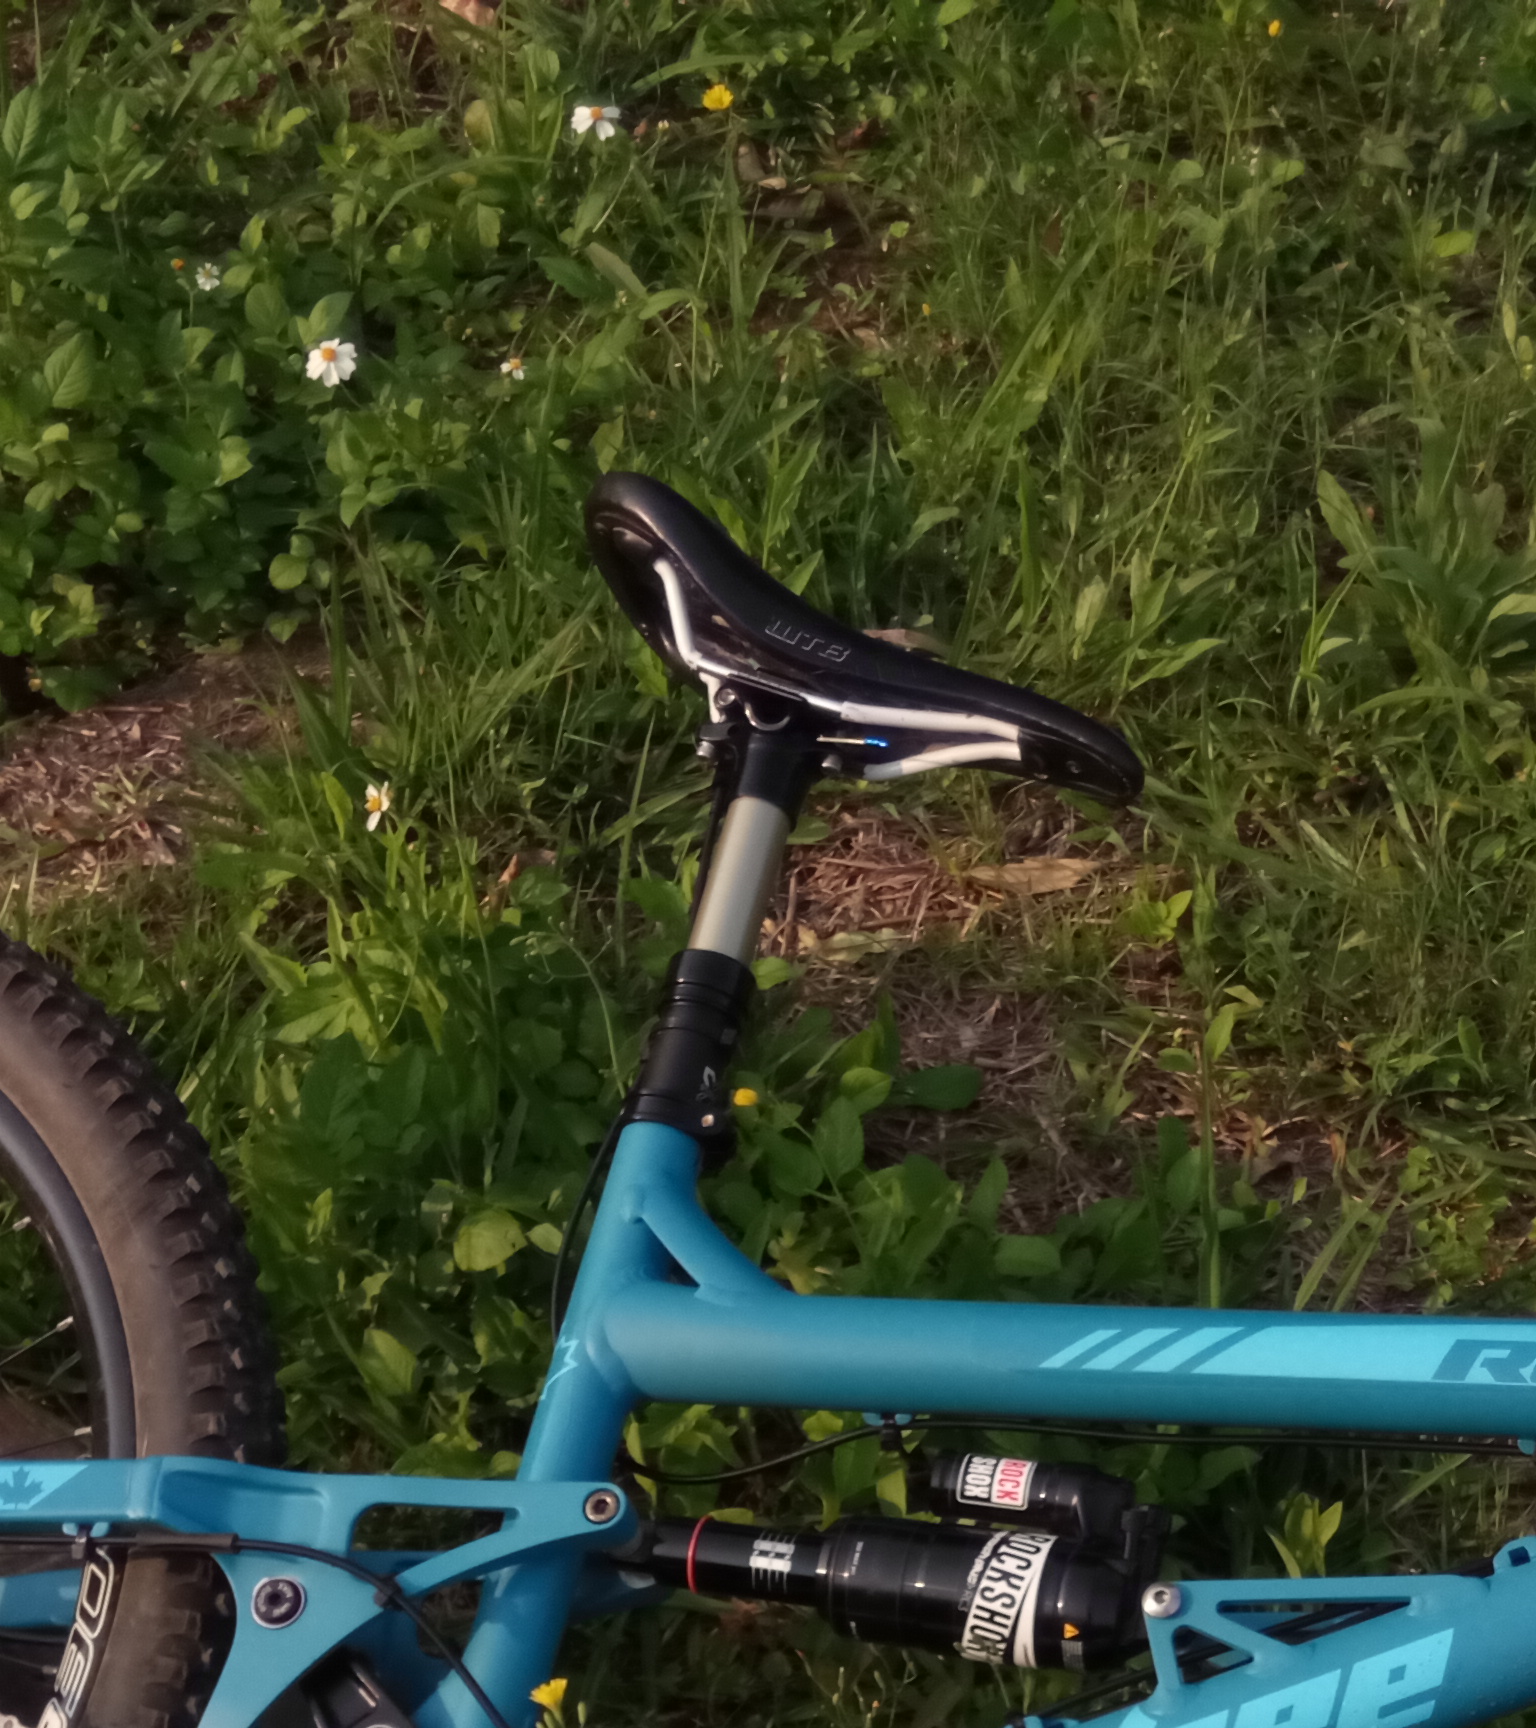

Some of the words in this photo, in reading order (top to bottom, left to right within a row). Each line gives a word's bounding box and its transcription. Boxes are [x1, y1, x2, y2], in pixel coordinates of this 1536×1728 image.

[764, 618, 852, 663] WTB
[963, 1456, 998, 1500] SHOX
[995, 1458, 1030, 1503] ROCK
